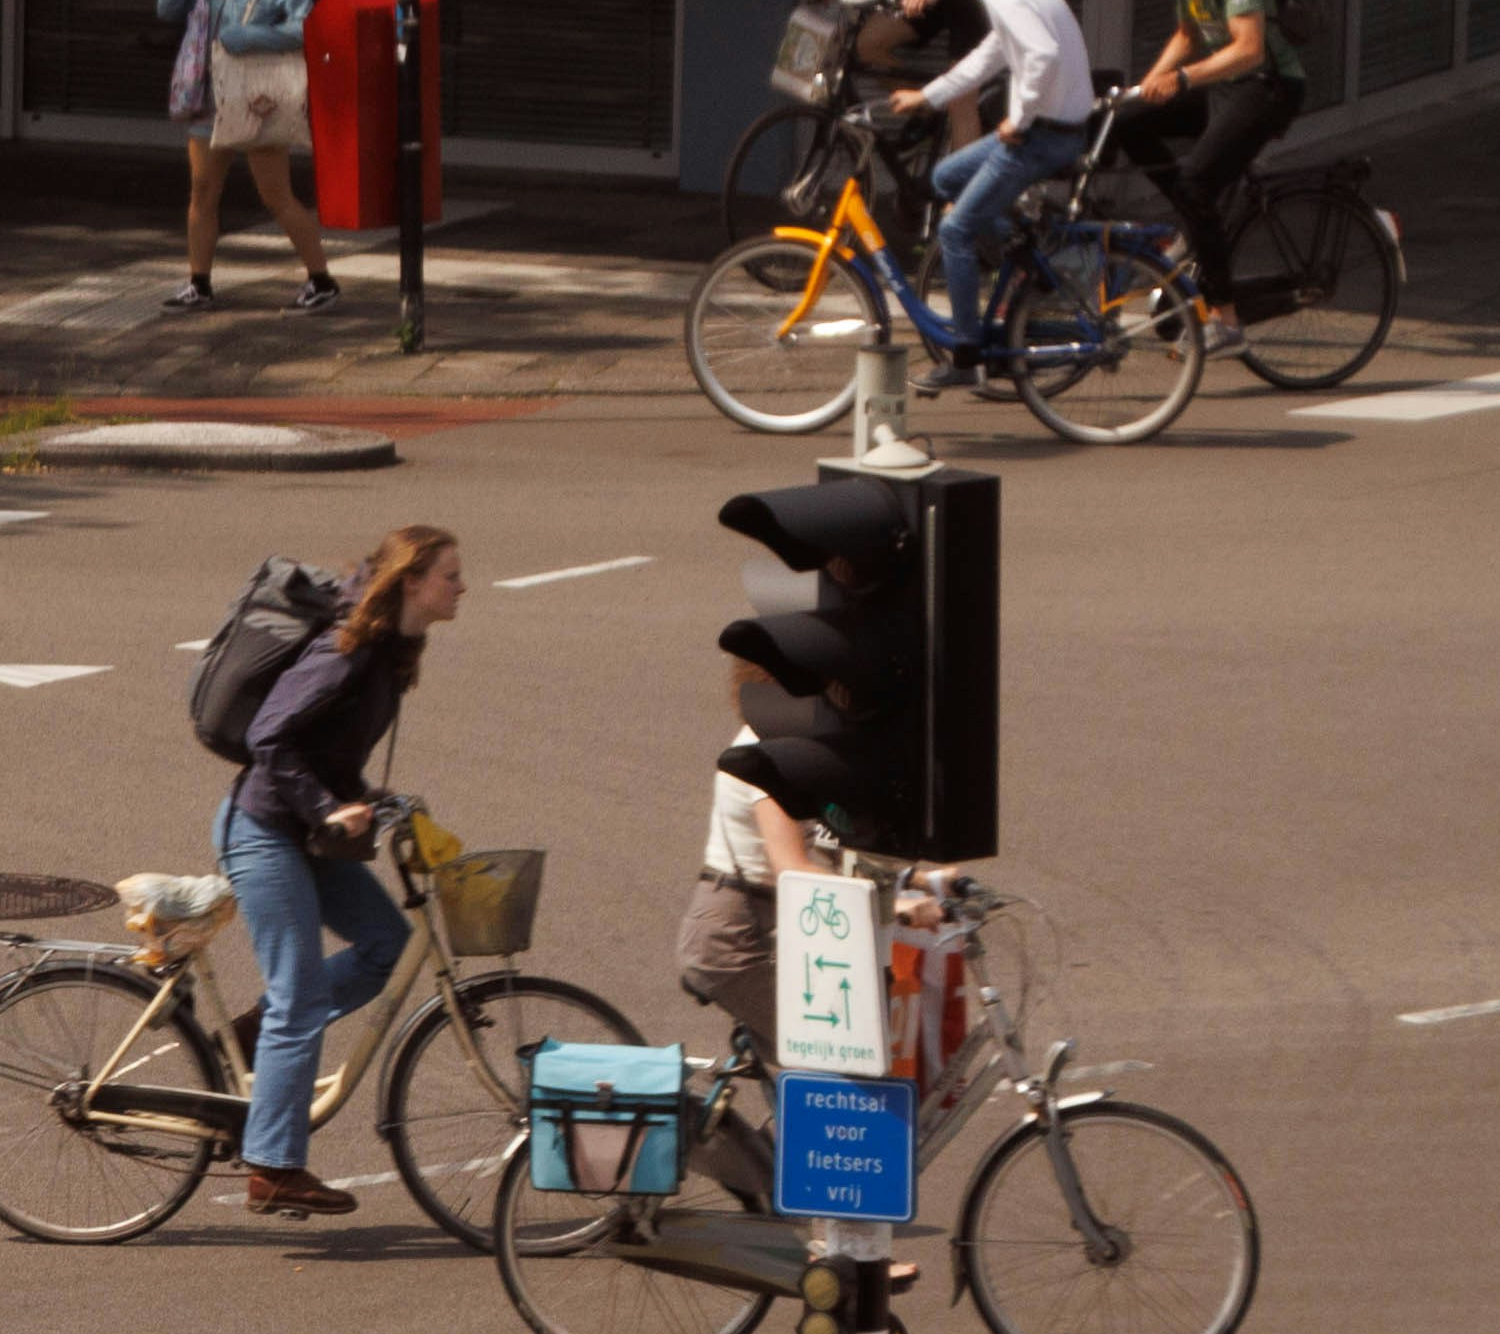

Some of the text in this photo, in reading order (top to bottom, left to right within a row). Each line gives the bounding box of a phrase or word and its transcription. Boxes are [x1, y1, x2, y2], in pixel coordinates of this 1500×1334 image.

[786, 1037, 876, 1064] tegelijk groen
[824, 1125, 867, 1141] voor
[806, 1150, 883, 1174] fietsers
[827, 1183, 862, 1209] vrij
